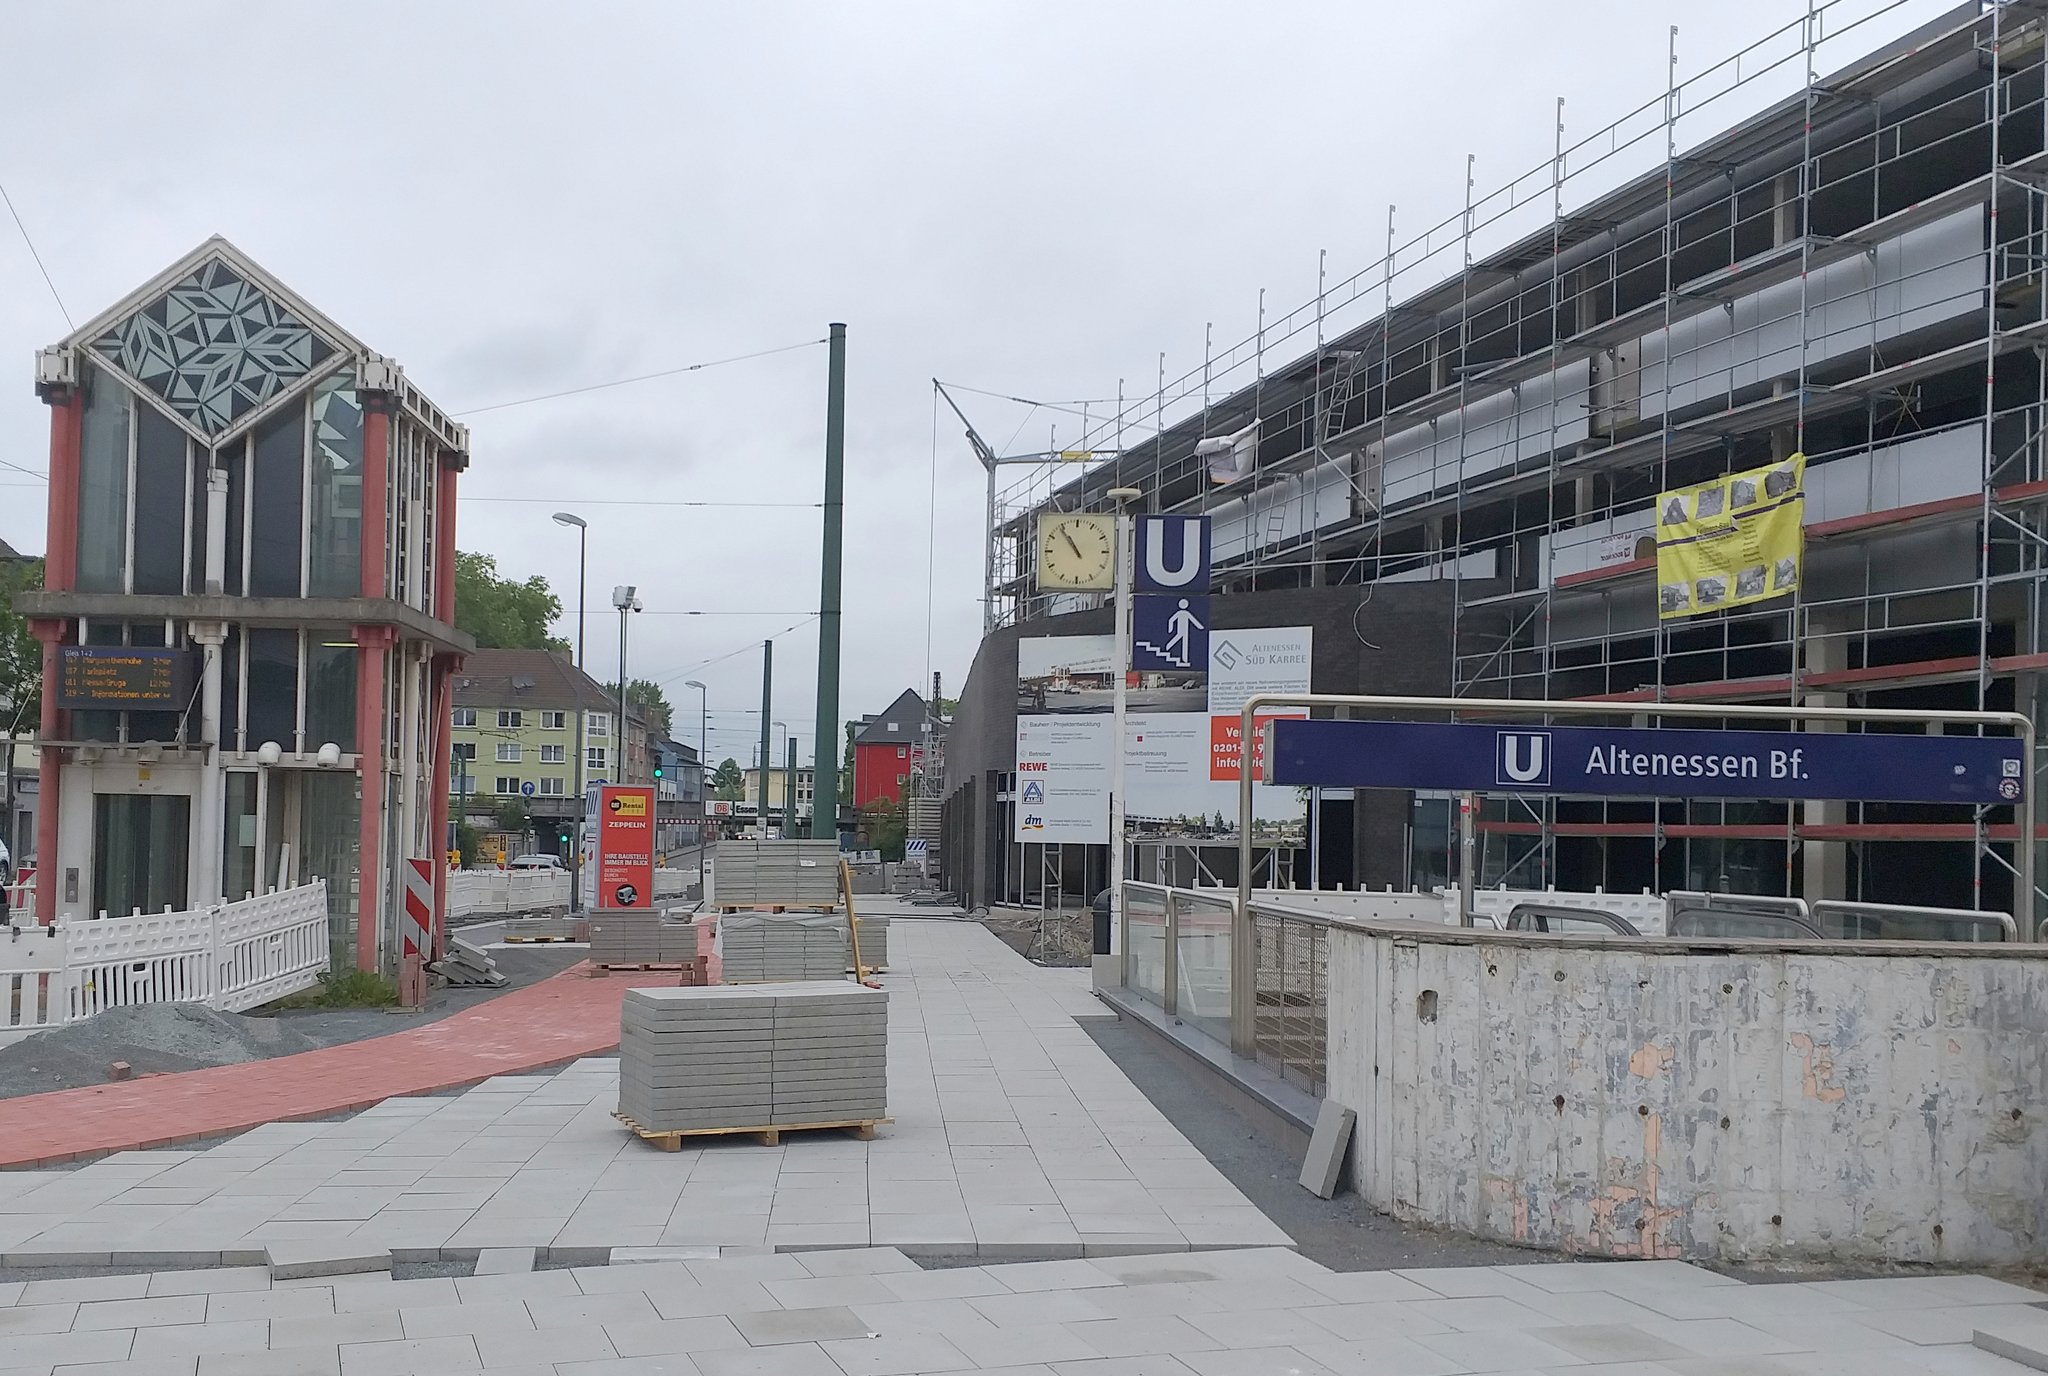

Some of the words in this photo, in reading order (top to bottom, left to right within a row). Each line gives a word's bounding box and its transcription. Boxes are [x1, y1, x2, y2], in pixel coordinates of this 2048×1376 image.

[1145, 518, 1201, 587] U
[1252, 643, 1301, 653] ALTENESSEN
[1245, 654, 1265, 666] SÜD
[1269, 654, 1307, 665] KARREE
[1504, 735, 1543, 781] U
[1585, 745, 1757, 778] Altenessen
[1770, 749, 1809, 779] Bf.
[1020, 762, 1048, 772] REWE
[716, 804, 728, 812] DB
[608, 821, 646, 829] ZEPPELIN
[1025, 814, 1042, 825] dm
